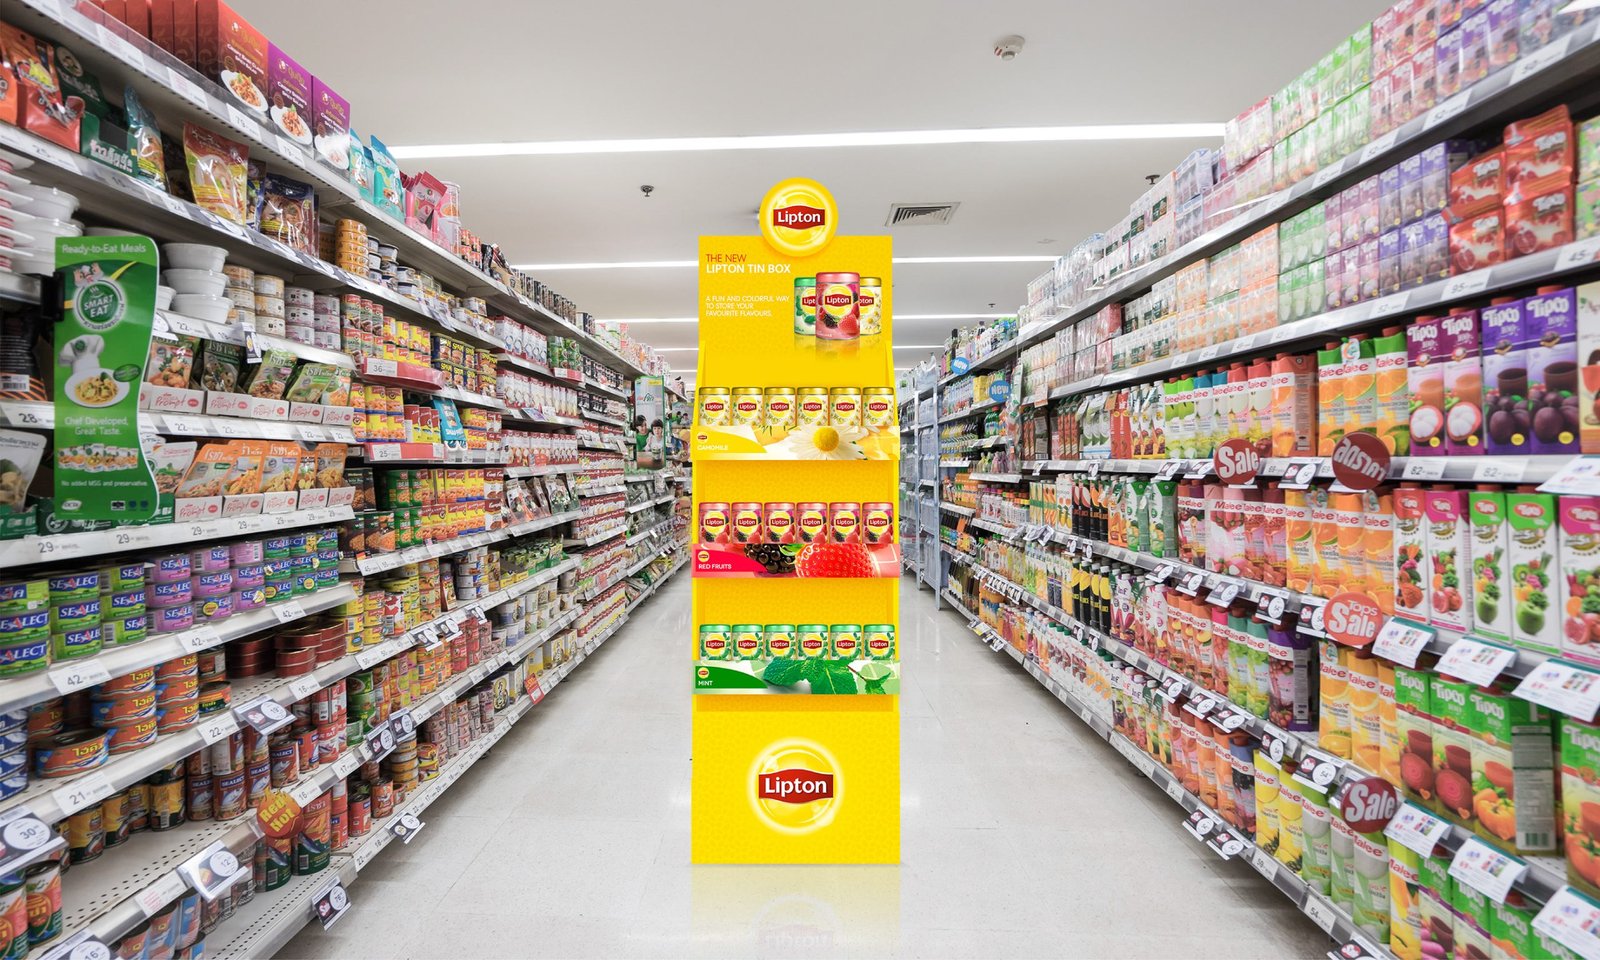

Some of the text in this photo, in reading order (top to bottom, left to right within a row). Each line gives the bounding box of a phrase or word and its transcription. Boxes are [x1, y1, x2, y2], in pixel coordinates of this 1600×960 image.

[777, 210, 821, 226] Lipton
[121, 243, 147, 253] Meals
[706, 254, 747, 263] THE NEW
[706, 264, 791, 274] LIPTON TIN BOX
[84, 294, 114, 311] SMART
[826, 295, 850, 306] Lipton
[90, 304, 109, 318] EAT
[1526, 297, 1570, 318] Tipco
[1482, 307, 1521, 328] Tipco
[1407, 324, 1438, 342] Tipco
[1441, 317, 1473, 336] Tipco
[18, 412, 38, 424] 28
[75, 427, 97, 435] Great
[175, 422, 188, 432] 22
[1218, 445, 1259, 479] Sale
[1334, 437, 1386, 481] ลดราคา
[706, 518, 724, 526] Lipton
[738, 518, 756, 526] Lipton
[771, 518, 789, 526] Lipton
[803, 518, 821, 526] Lipton
[836, 518, 854, 526] Lipton
[869, 518, 887, 526] Lipton
[192, 526, 203, 536] 29
[116, 533, 131, 545] 29
[38, 541, 54, 553] 29
[50, 575, 99, 589] SEALECT
[156, 581, 191, 594] SEALEC
[60, 602, 100, 617] SEALEC
[1348, 599, 1378, 616] Tops
[0, 612, 49, 631] EALECT
[1329, 602, 1377, 638] Sale
[191, 637, 203, 648] 42
[67, 674, 83, 686] 42
[1396, 669, 1425, 693] Tipco
[1431, 680, 1465, 706] Tipco
[1470, 693, 1505, 721] Tipco
[209, 726, 222, 738] 22
[765, 776, 827, 797] Lipton
[69, 791, 87, 806] 21
[1344, 783, 1395, 823] Sale
[19, 827, 37, 840] 30
